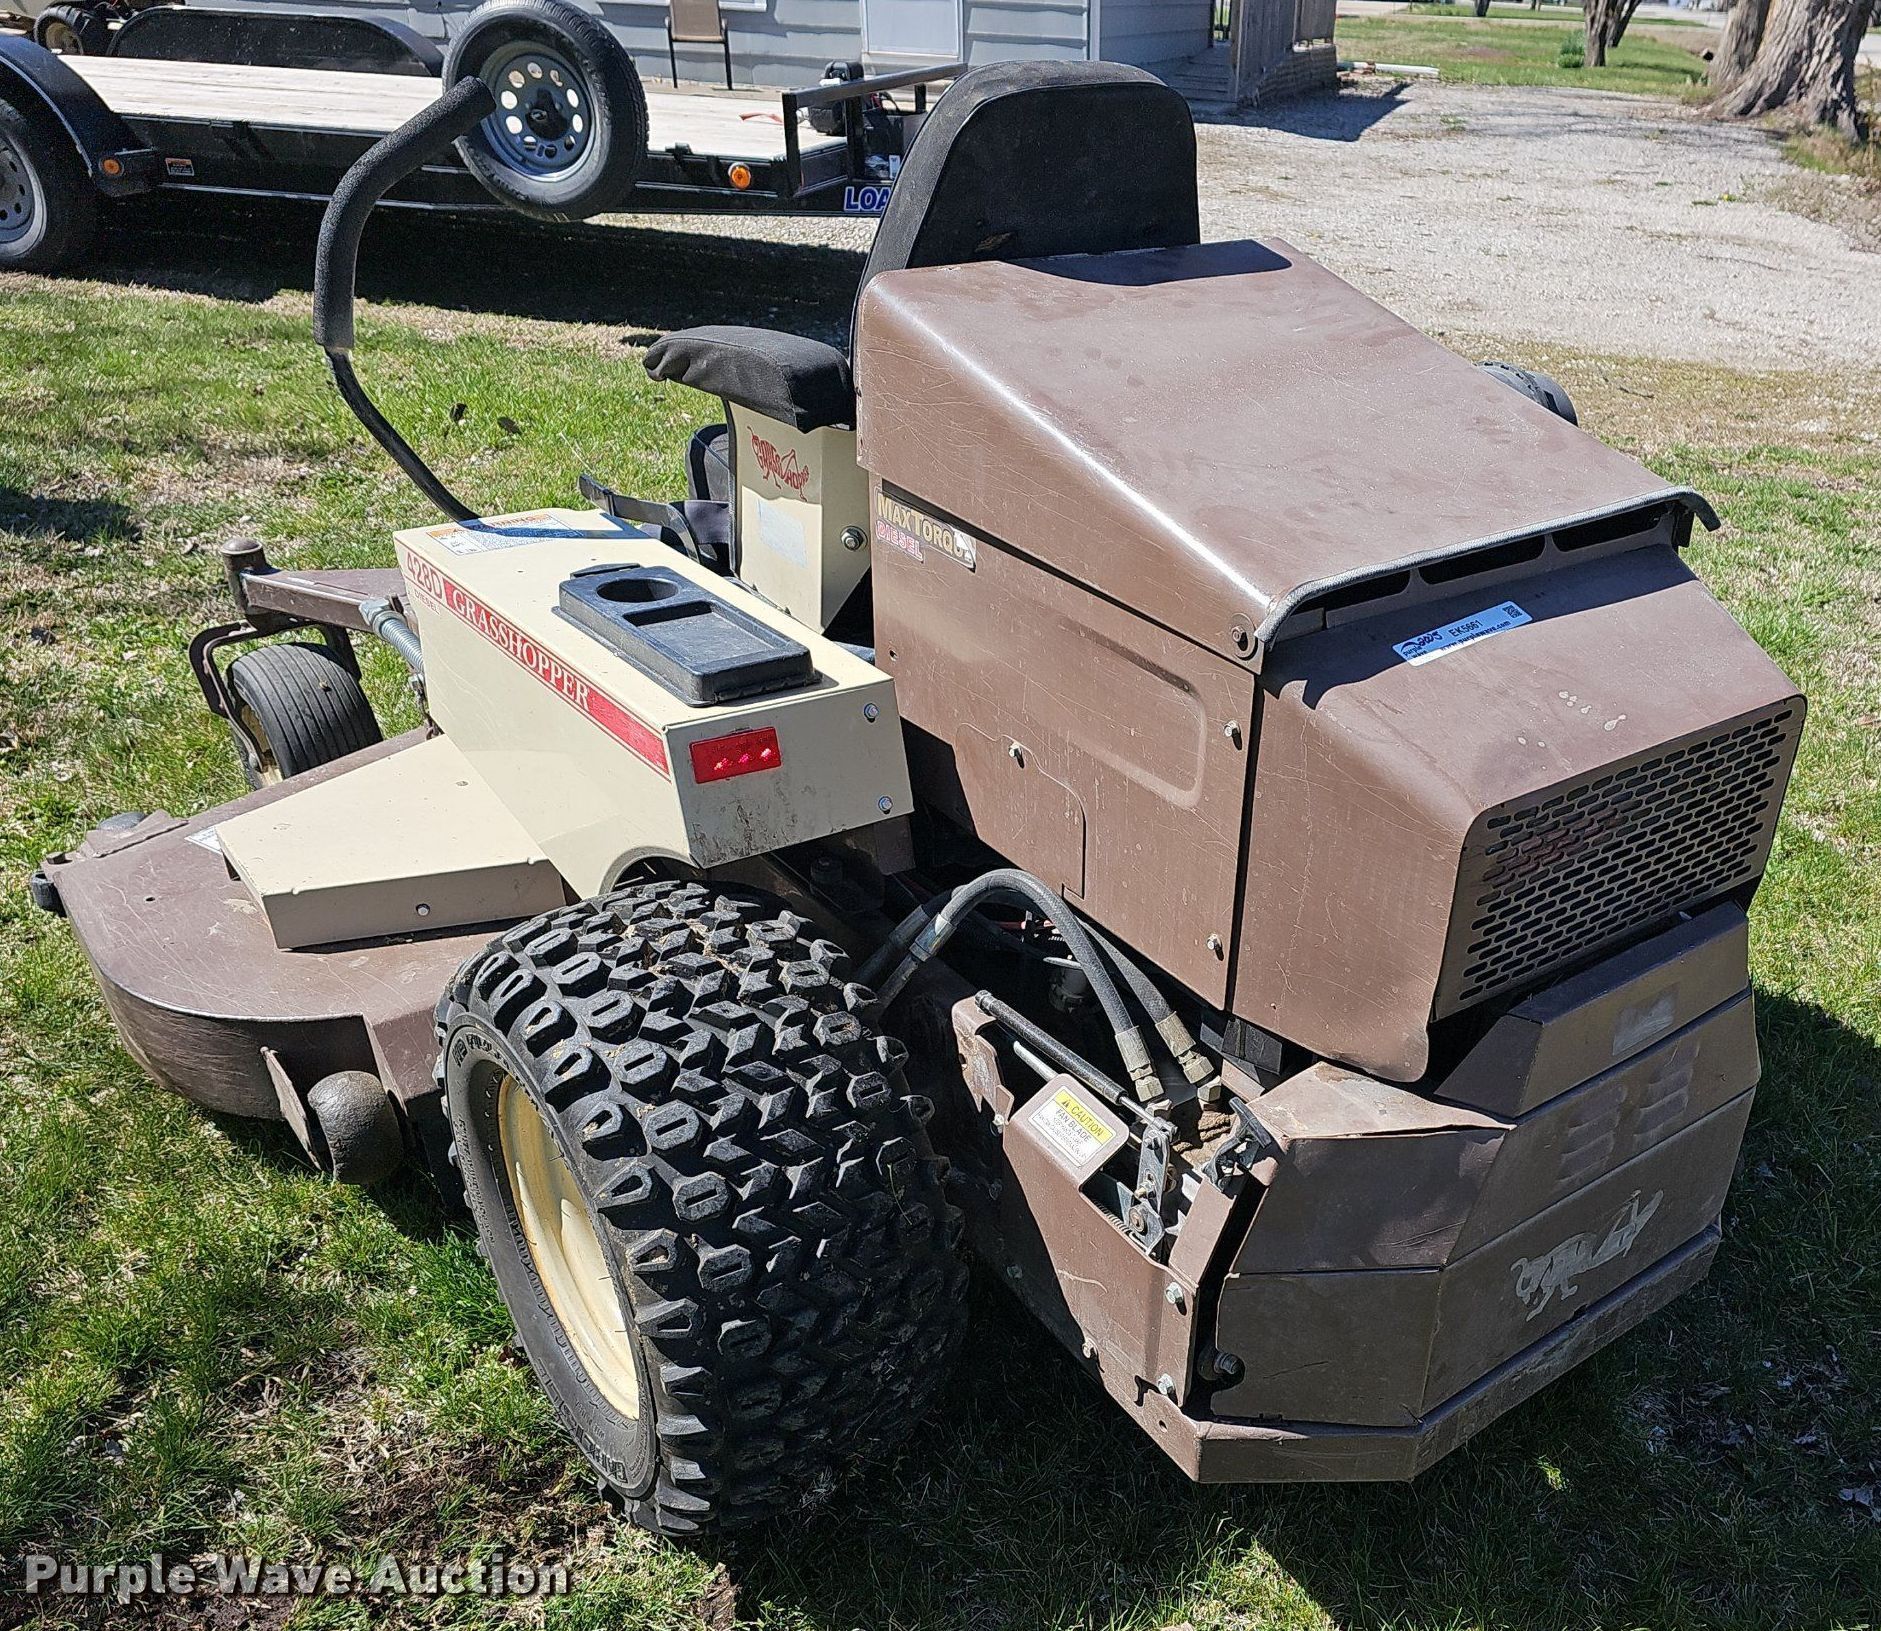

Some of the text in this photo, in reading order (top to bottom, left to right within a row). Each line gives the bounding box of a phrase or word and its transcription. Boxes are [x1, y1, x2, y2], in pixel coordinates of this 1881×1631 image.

[876, 520, 923, 562] DIESEL
[406, 551, 591, 712] 428D GRASSHOPPER
[1448, 619, 1483, 637] EK5661
[1055, 1108, 1070, 1126] FAN
[1068, 1120, 1091, 1142] BLADE
[1071, 1105, 1104, 1137] CAUTION
